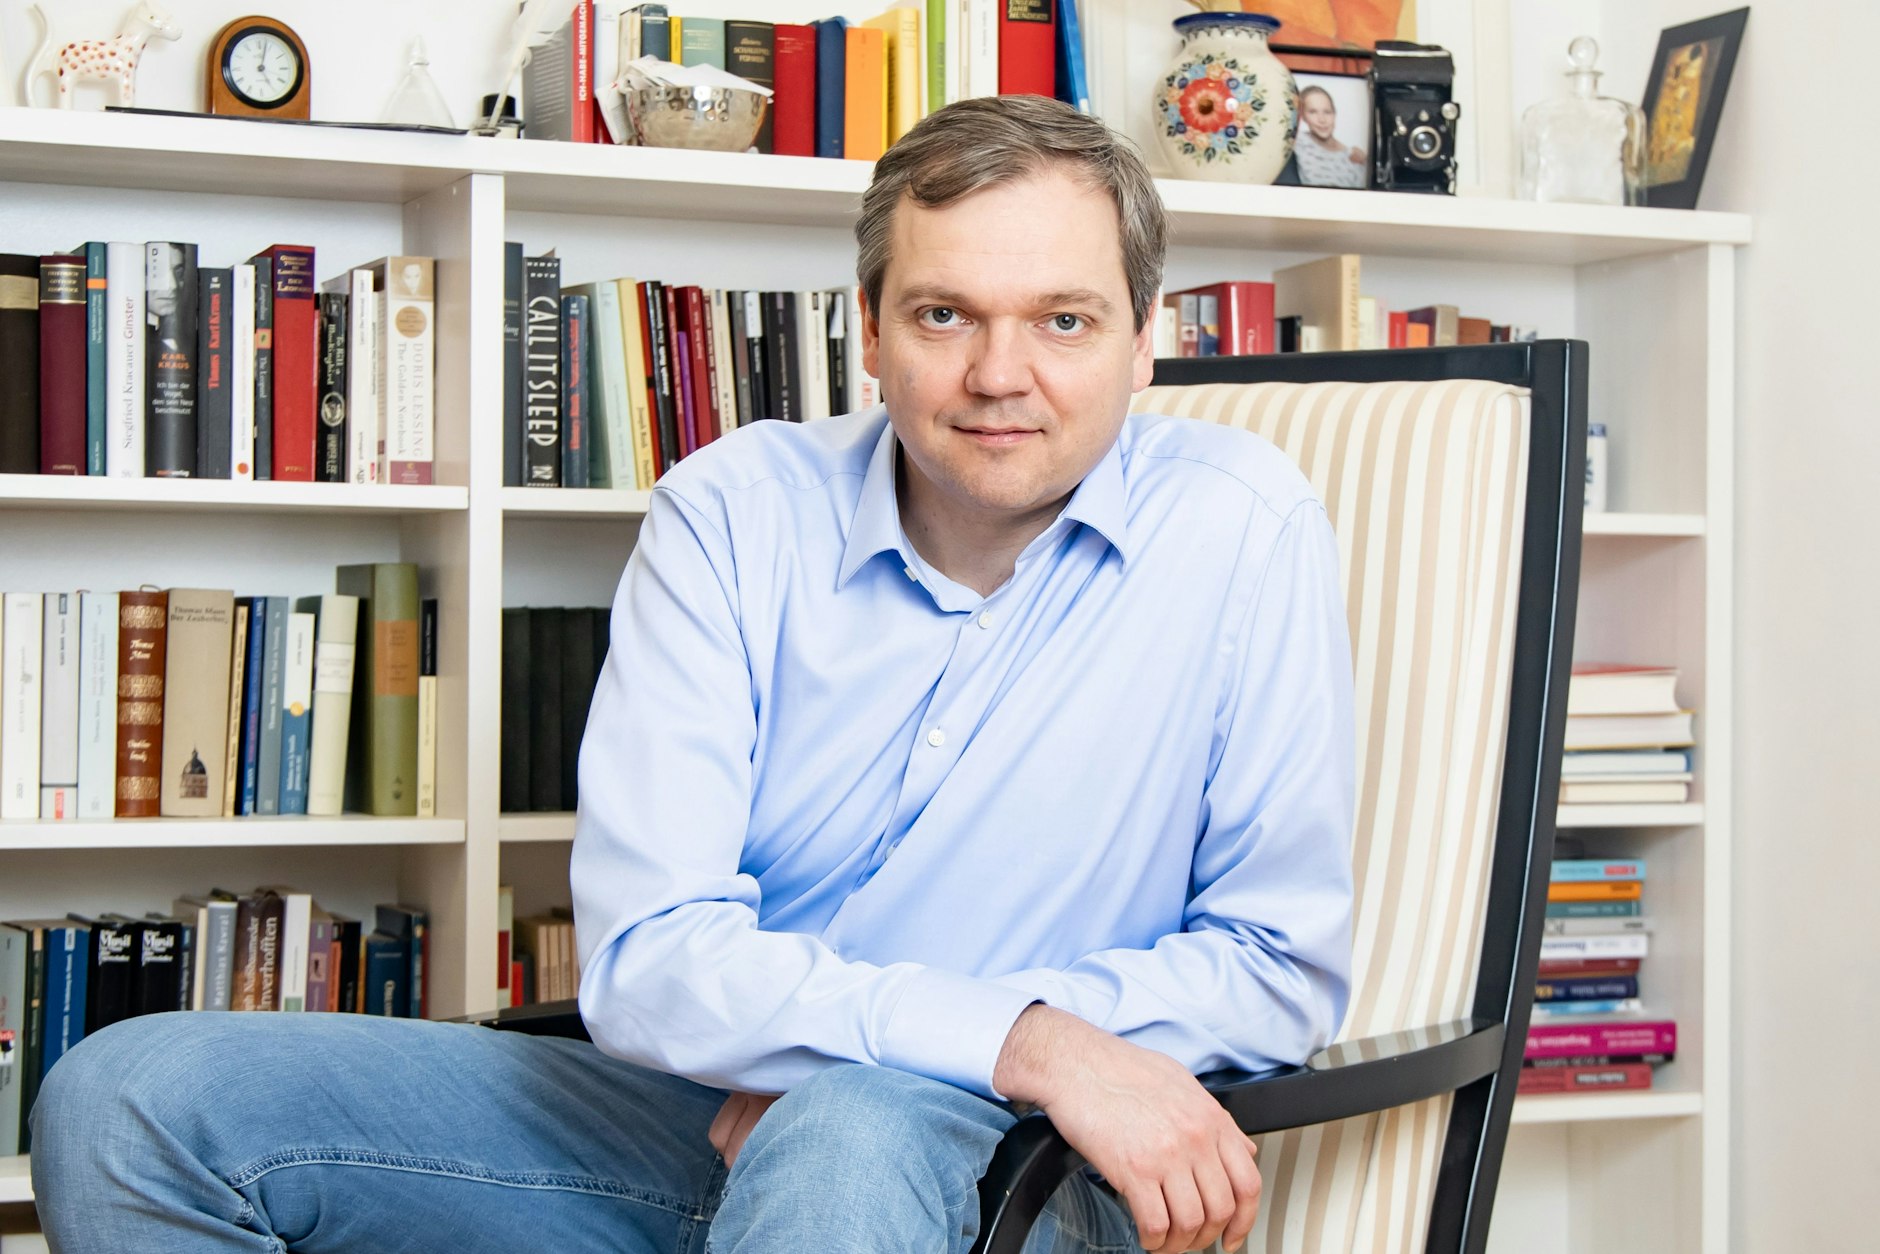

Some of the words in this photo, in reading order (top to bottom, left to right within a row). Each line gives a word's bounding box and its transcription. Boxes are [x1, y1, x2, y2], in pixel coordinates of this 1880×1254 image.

[123, 296, 135, 340] Ginster
[528, 296, 558, 346] CALL
[123, 344, 134, 394] Kracauer
[157, 361, 191, 370] KRAUS
[161, 352, 186, 361] KARL
[325, 323, 337, 386] Mockingbird
[335, 348, 345, 366] Kill
[397, 343, 407, 361] The
[412, 343, 424, 388] DORIS
[528, 354, 558, 376] IT
[397, 364, 407, 402] Golden
[122, 398, 134, 449] Siegfried
[397, 405, 407, 455] Notebook
[412, 394, 424, 457] LESSING
[528, 380, 558, 447] SLEEP
[216, 914, 230, 954] Nawrat
[213, 956, 227, 1007] Matthias
